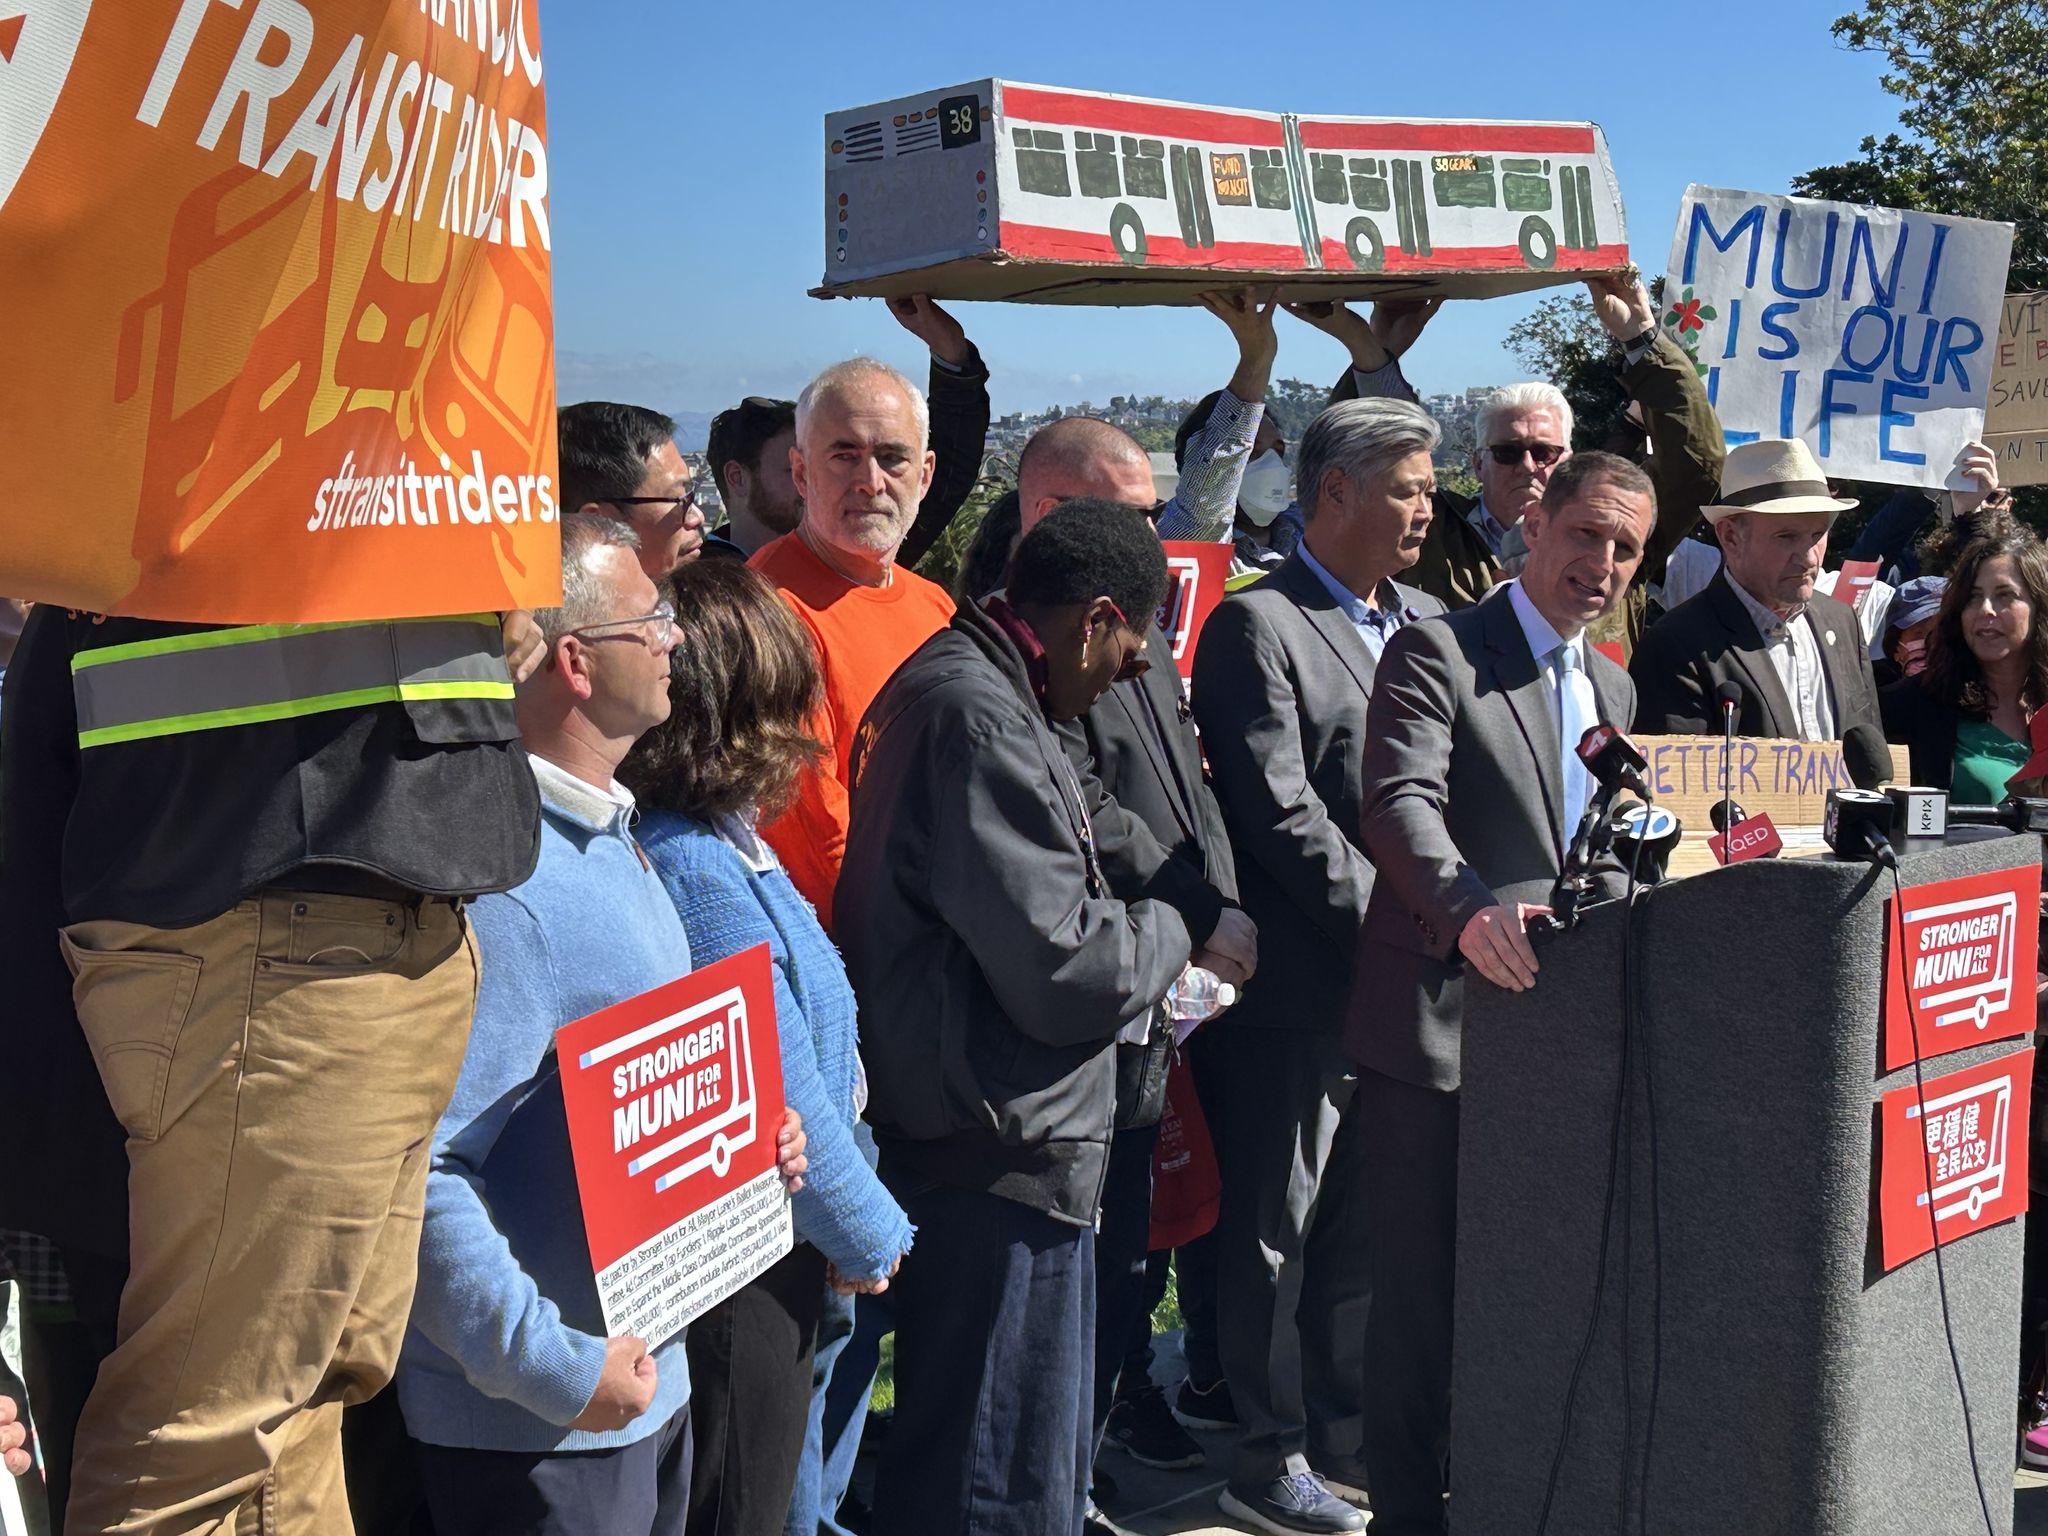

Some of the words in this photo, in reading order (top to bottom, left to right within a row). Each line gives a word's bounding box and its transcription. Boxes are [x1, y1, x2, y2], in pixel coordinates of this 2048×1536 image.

[136, 0, 453, 222] TRANSIT
[950, 105, 973, 135] 38
[1213, 156, 1241, 176] FUND
[1435, 157, 1449, 171] 38
[1682, 202, 1951, 314] MUNI
[1722, 299, 1800, 361] IS
[1841, 305, 1984, 392] OUR
[1708, 366, 1930, 465] LIFE
[1920, 798, 1933, 831] KPIX
[1920, 914, 1999, 951] STRONGER
[1913, 946, 1973, 989] MUNI
[1970, 959, 1988, 976] ALL
[1973, 944, 1992, 961] FOR
[613, 1021, 725, 1099] STRONGER
[697, 1063, 722, 1090] FOR
[613, 1073, 695, 1153] MUNI
[697, 1084, 722, 1111] ALL
